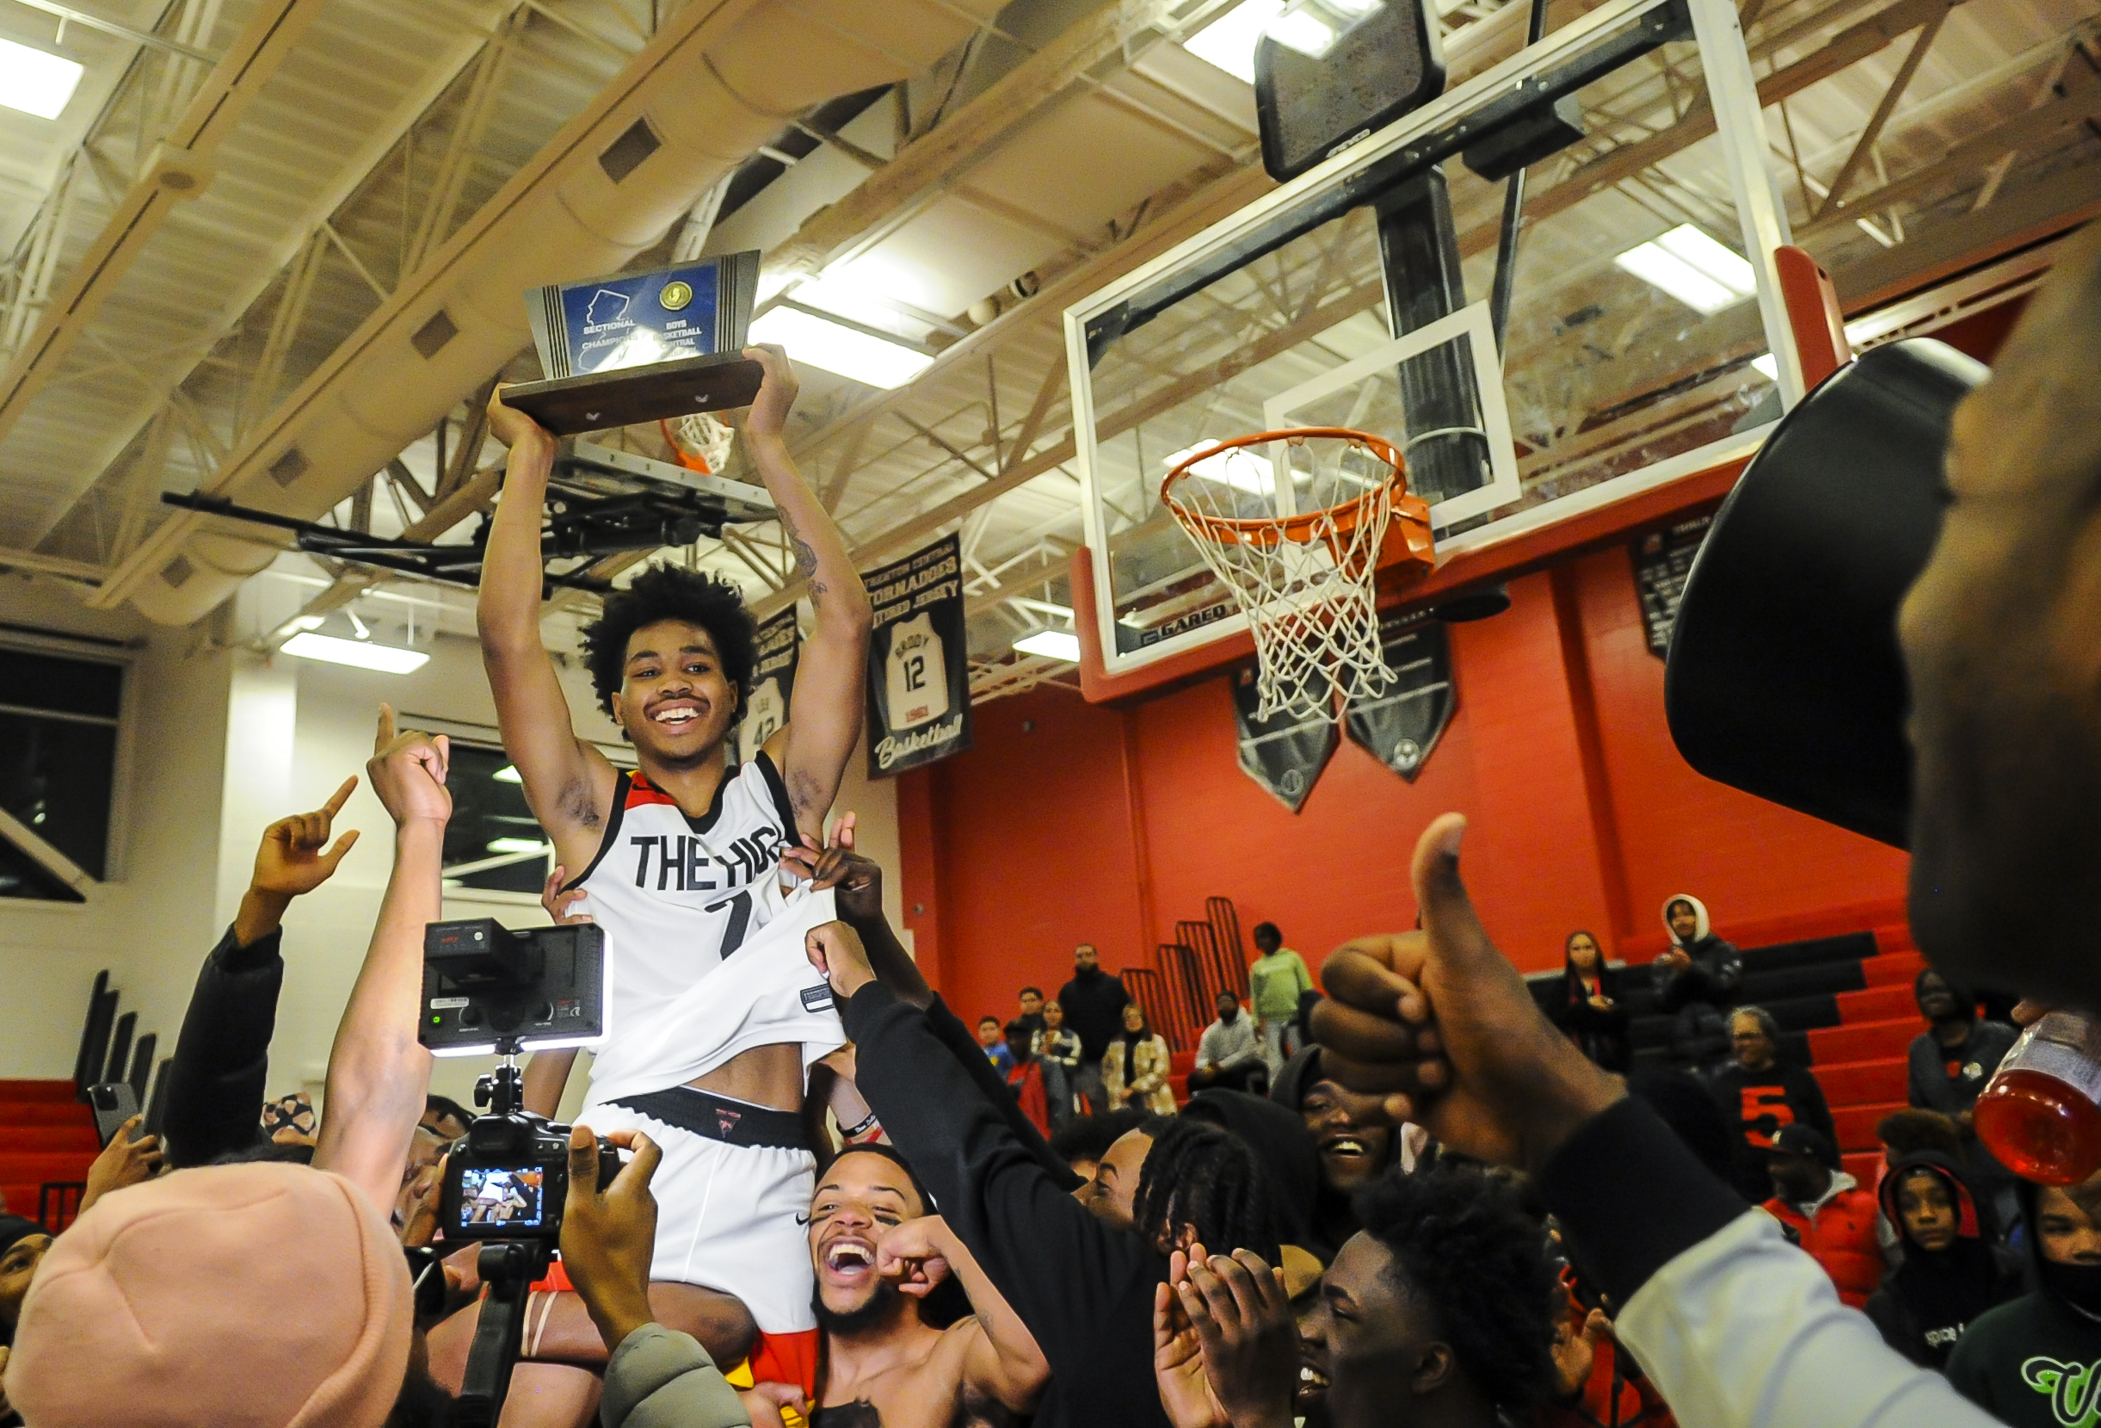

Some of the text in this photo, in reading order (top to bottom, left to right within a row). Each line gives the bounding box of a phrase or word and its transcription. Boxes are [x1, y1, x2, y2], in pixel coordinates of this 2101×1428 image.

[583, 319, 636, 335] SECTIONAL
[666, 319, 687, 330] BOYS
[1161, 604, 1227, 637] GARED
[904, 655, 926, 692] 12
[874, 713, 963, 769] Basketball
[630, 826, 779, 891] THE HIG
[704, 889, 753, 961] 7
[1741, 1086, 1795, 1149] 5
